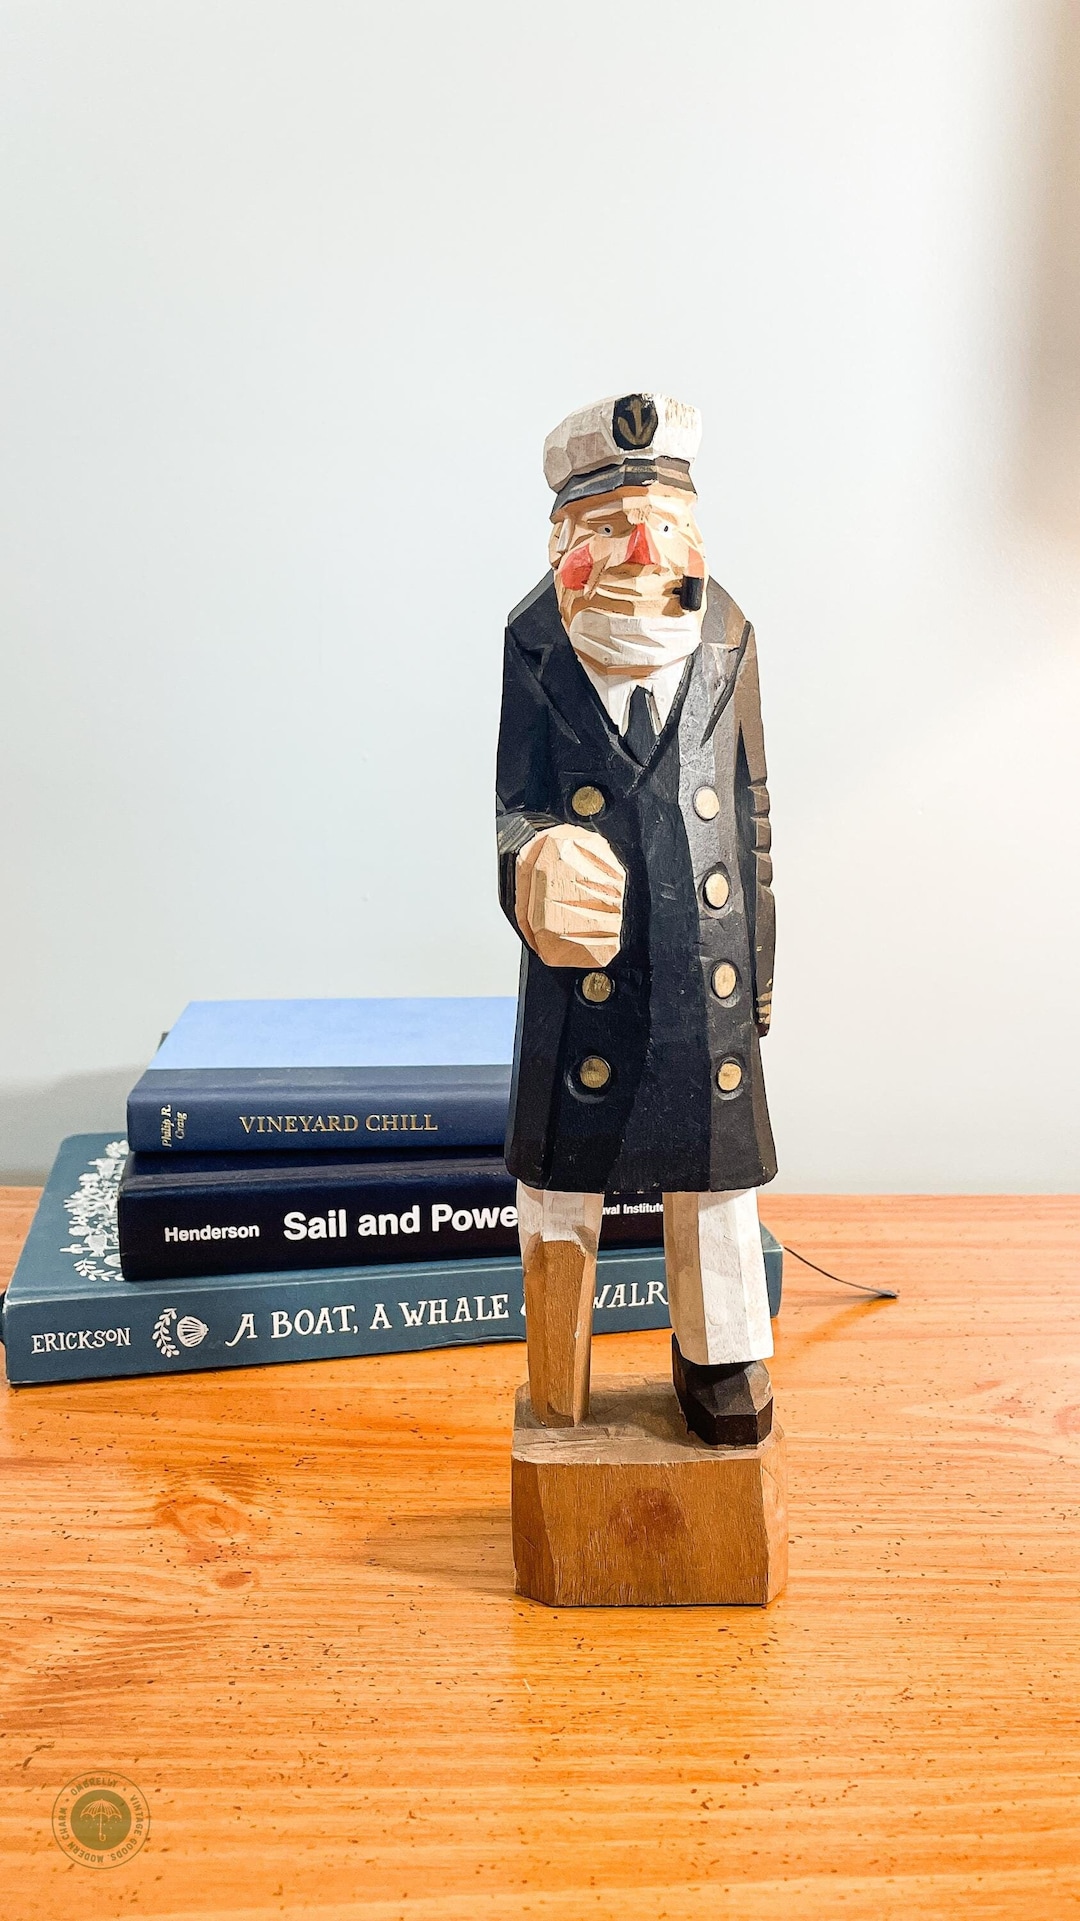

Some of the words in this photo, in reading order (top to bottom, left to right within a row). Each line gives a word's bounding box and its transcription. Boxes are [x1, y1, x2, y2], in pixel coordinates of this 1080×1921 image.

[161, 1104, 171, 1118] R.
[239, 1115, 359, 1133] VINEYARD
[365, 1114, 438, 1132] CHILL
[161, 1118, 175, 1148] Philip
[174, 1111, 188, 1140] Craig
[283, 1208, 347, 1241] Sail
[357, 1204, 421, 1236] and
[431, 1203, 519, 1232] Powe
[601, 1203, 621, 1216] aval
[164, 1225, 260, 1242] Henderson
[224, 1313, 258, 1347] A
[270, 1304, 359, 1339] BOAT,
[369, 1303, 393, 1330] A
[398, 1293, 510, 1328] WHALE
[592, 1280, 669, 1310] WALR
[31, 1327, 131, 1354] ERICKSON
